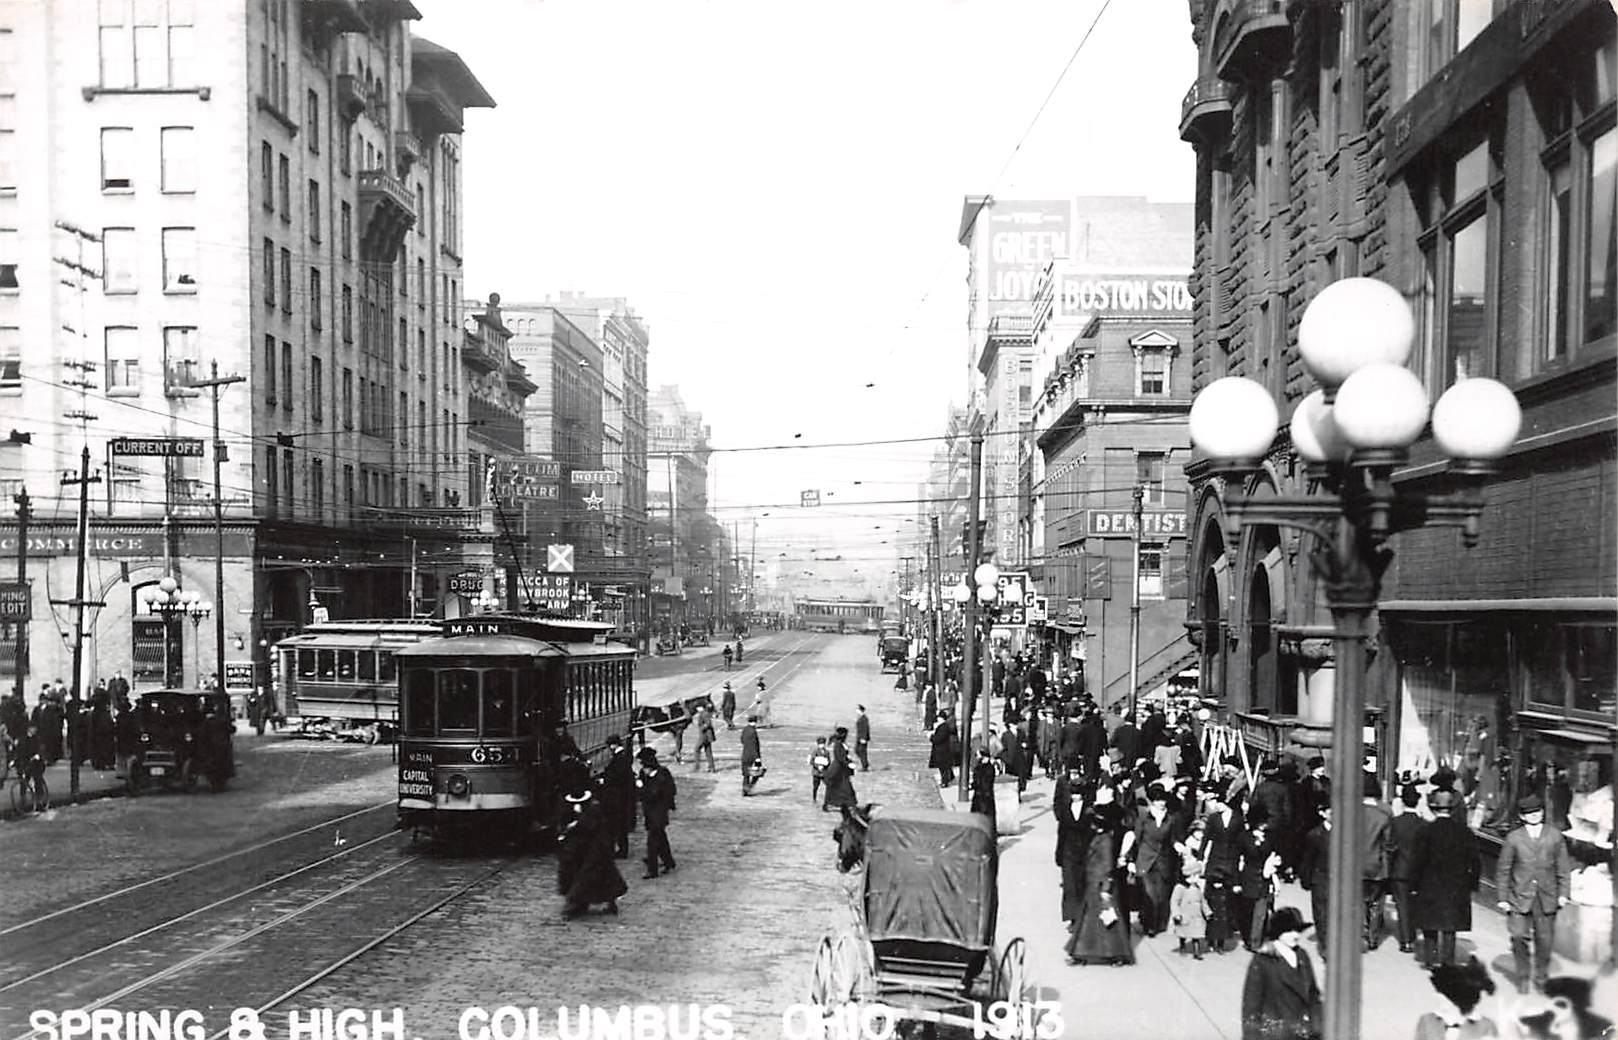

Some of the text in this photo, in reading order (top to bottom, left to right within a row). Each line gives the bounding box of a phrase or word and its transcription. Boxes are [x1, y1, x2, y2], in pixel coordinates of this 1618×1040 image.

[993, 231, 1066, 264] GREEN
[1065, 280, 1193, 311] BOSTON STO
[114, 442, 171, 453] CURRENT
[1096, 512, 1187, 533] DENTIST
[1, 538, 143, 550] COMMRCE
[555, 576, 570, 586] OF
[451, 625, 499, 634] MAIN
[409, 753, 433, 763] MAIN
[402, 769, 429, 782] CAPITAL
[400, 783, 433, 795] UNIVERSITY
